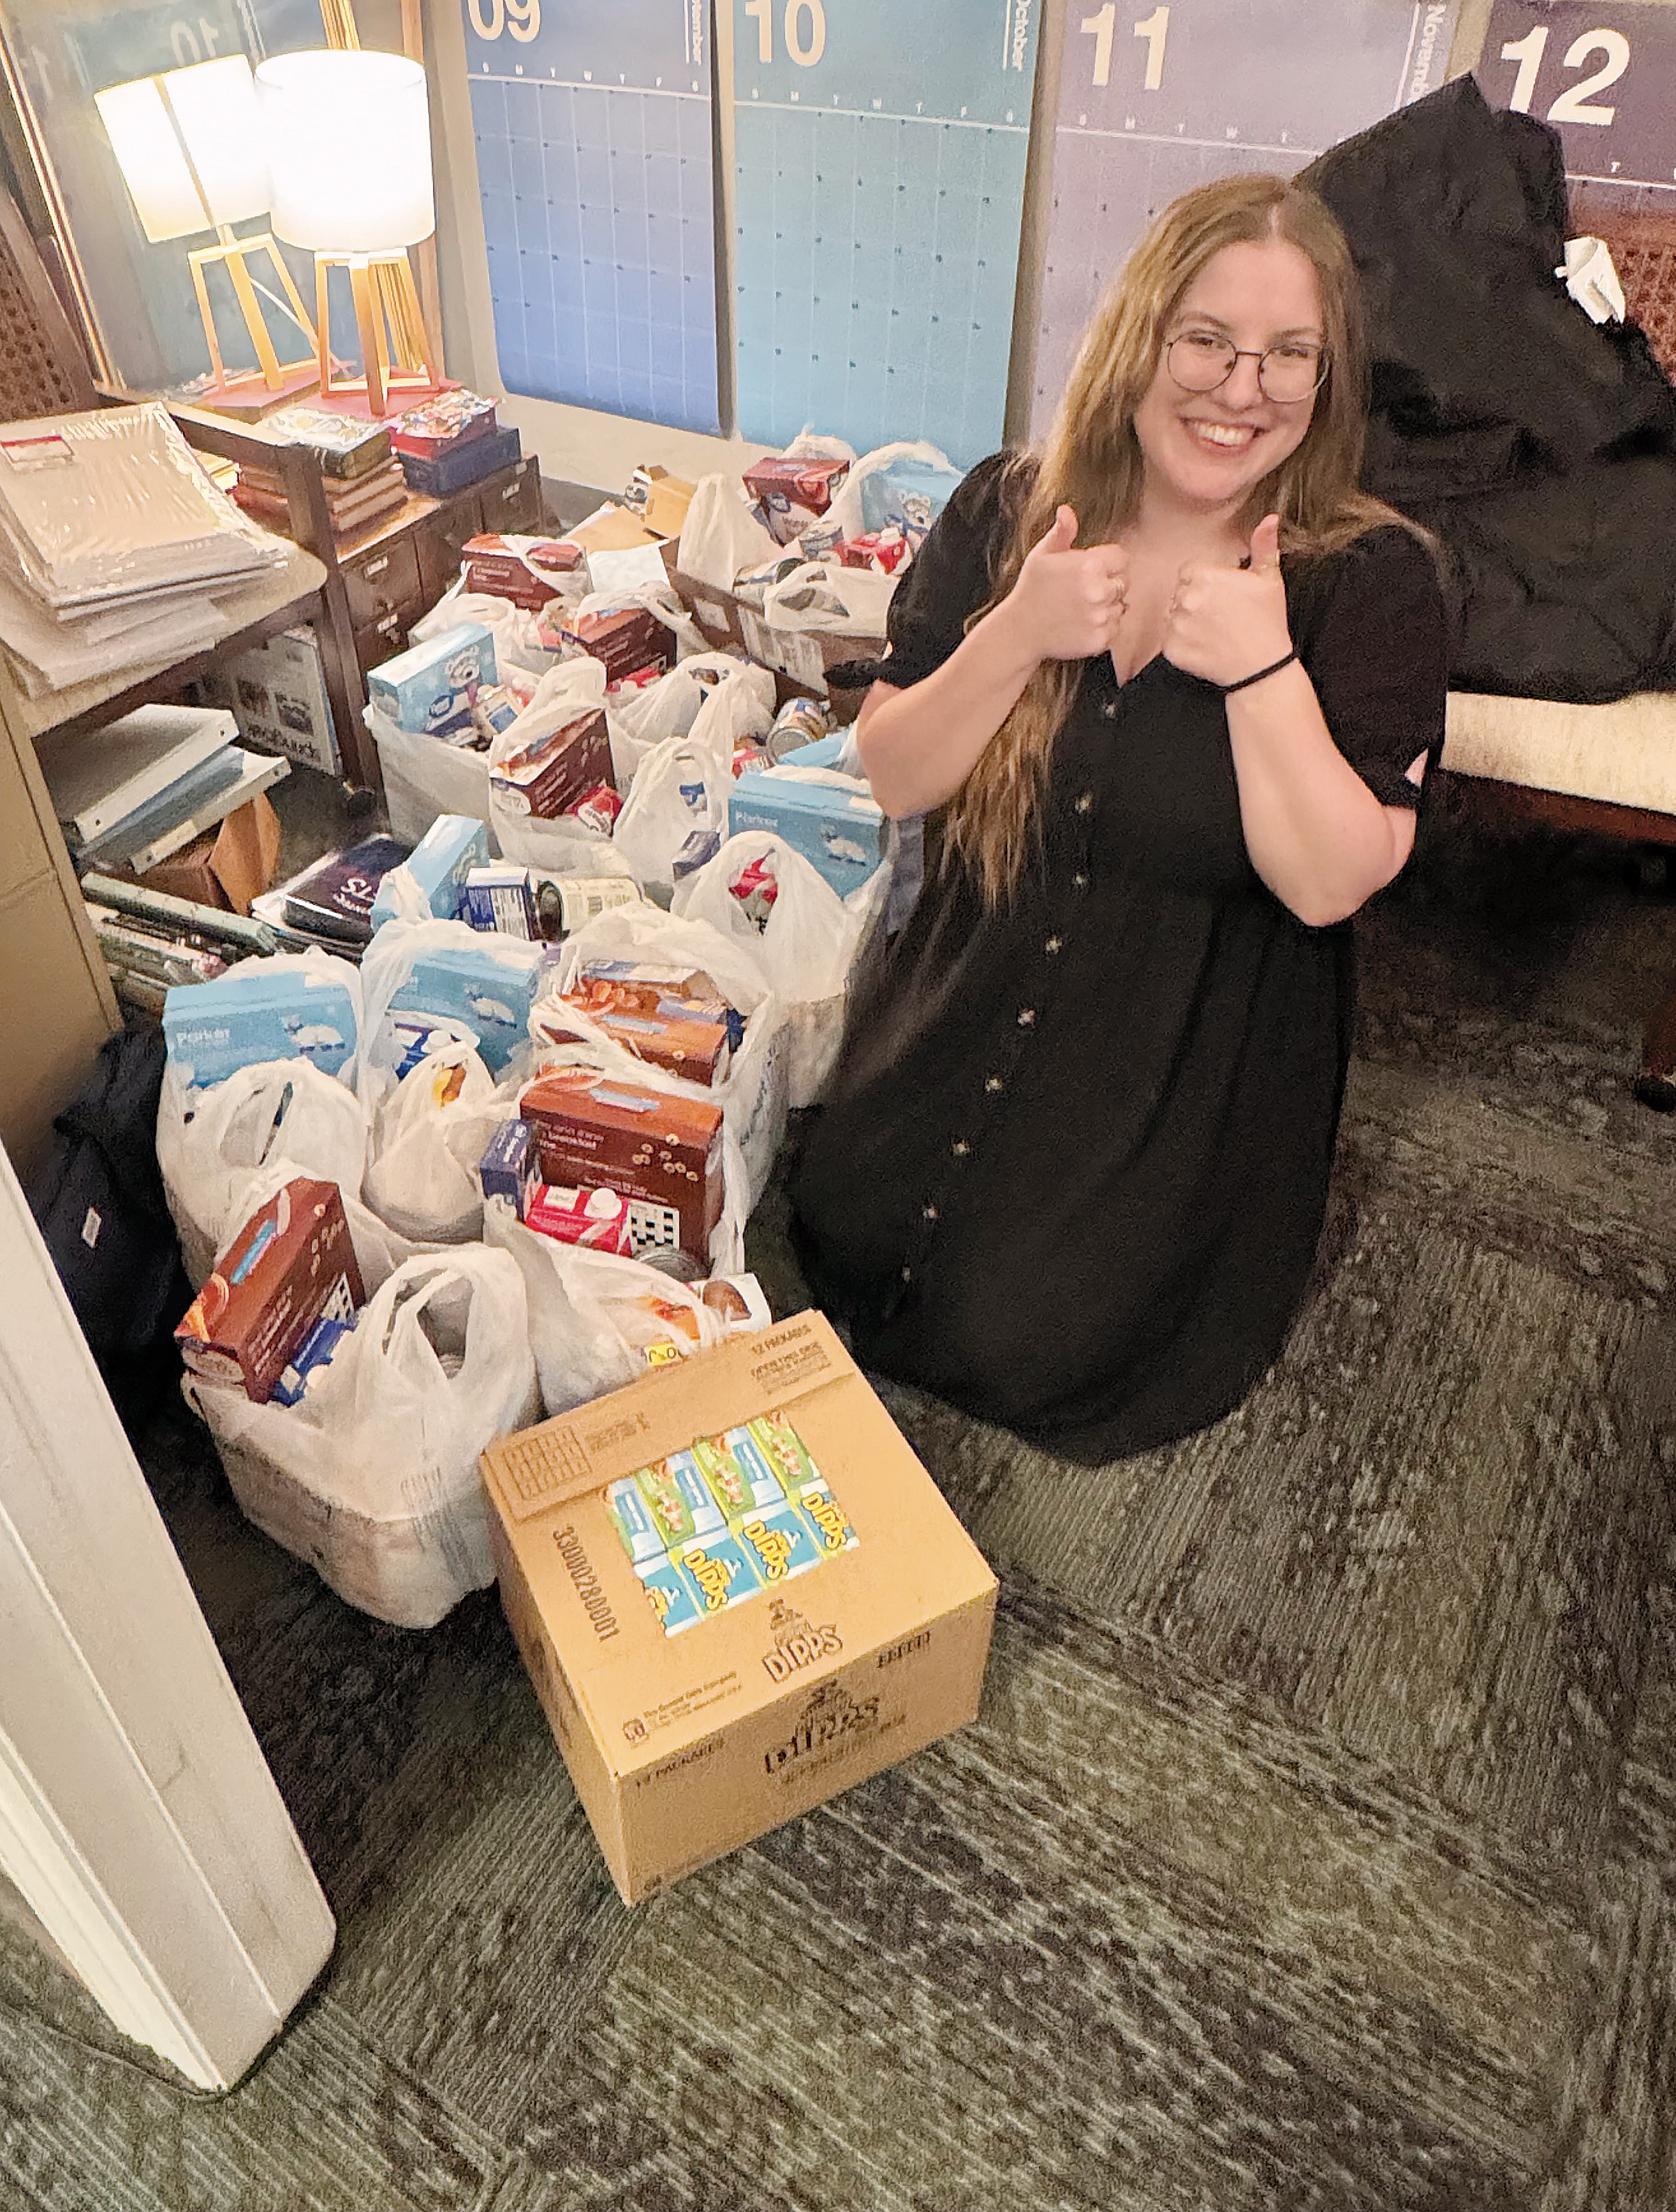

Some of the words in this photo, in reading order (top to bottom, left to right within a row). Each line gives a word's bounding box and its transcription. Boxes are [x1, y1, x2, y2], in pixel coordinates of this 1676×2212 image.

[467, 0, 541, 43] 09
[744, 0, 827, 68] 10
[1080, 2, 1171, 91] 11
[1501, 24, 1632, 126] 12
[744, 1519, 789, 1580] DIPPS
[803, 1491, 847, 1550] DIPPS
[683, 1548, 729, 1611] DIPPS
[761, 1623, 844, 1684] DIPPS
